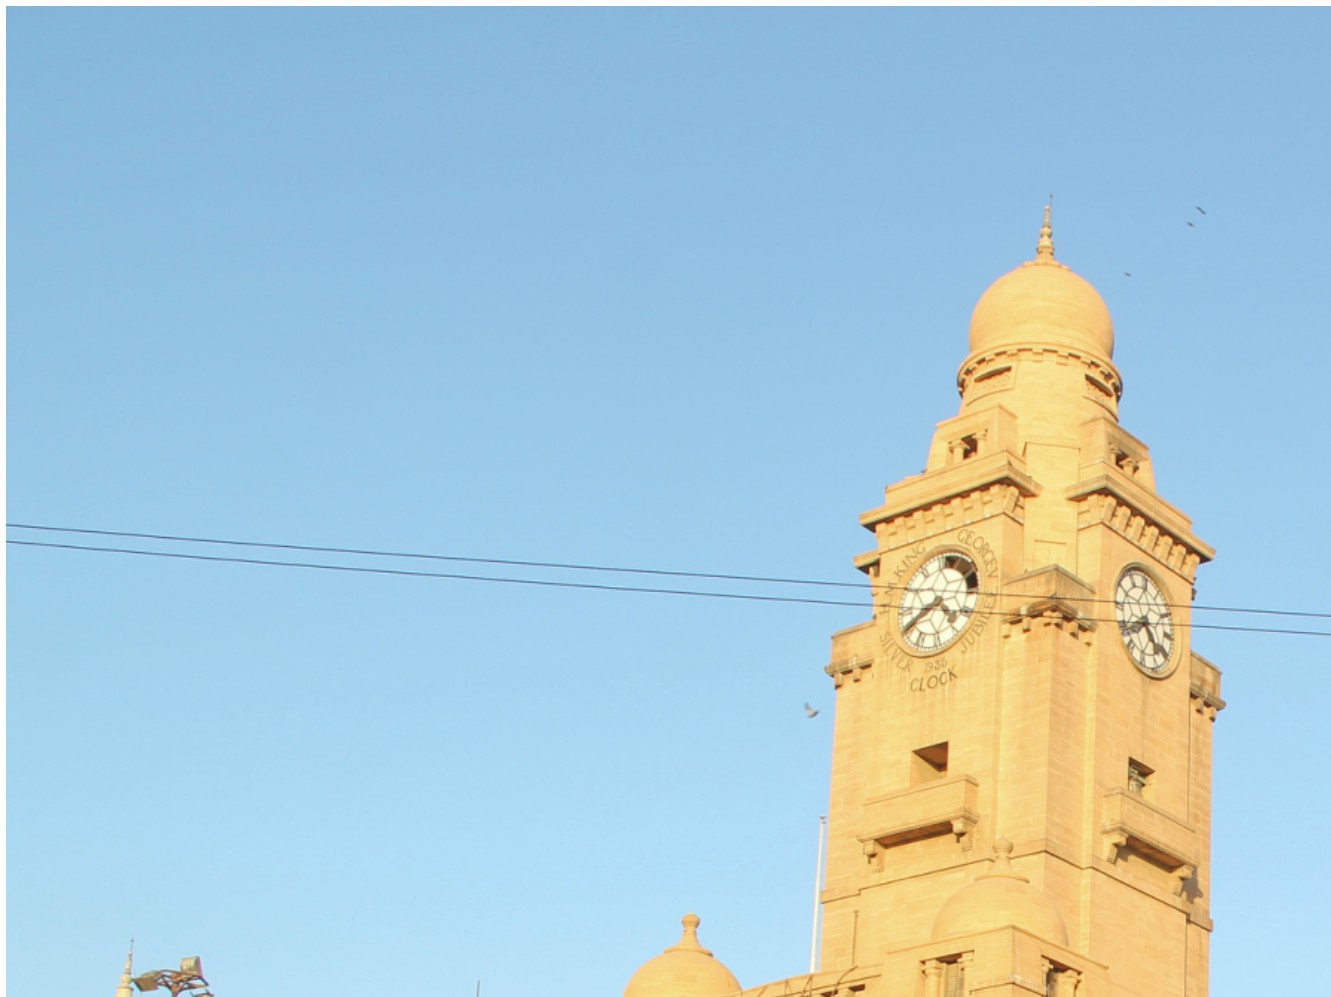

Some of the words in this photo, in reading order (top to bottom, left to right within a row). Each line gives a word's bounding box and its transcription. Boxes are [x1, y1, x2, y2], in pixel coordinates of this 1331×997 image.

[893, 543, 926, 578] KING
[879, 631, 914, 673] SILVER
[910, 665, 957, 691] CLOCK
